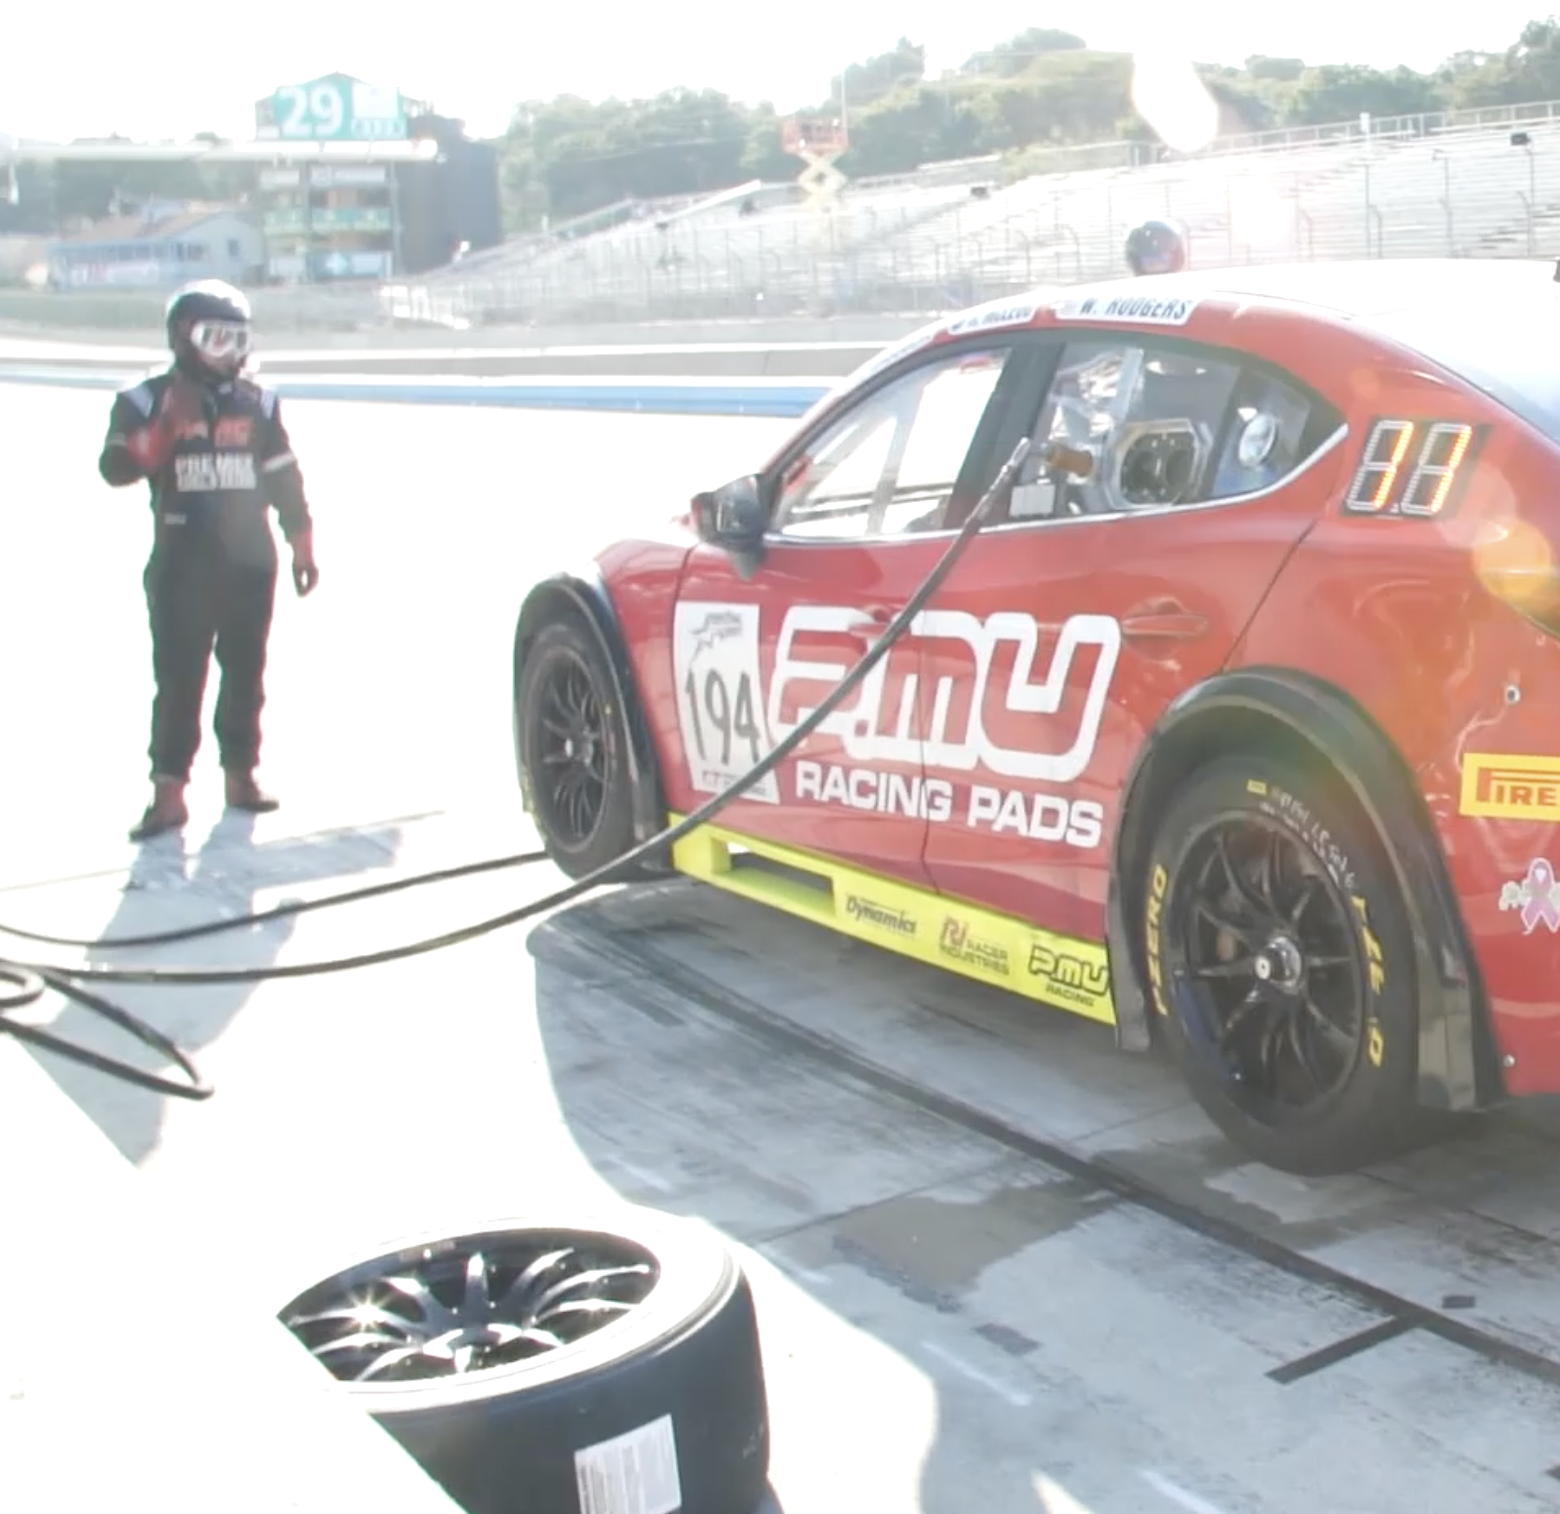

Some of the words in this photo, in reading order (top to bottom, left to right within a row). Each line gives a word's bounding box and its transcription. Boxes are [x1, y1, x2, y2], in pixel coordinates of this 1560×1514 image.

[272, 82, 343, 138] 29
[684, 668, 763, 766] 194
[796, 760, 953, 822] RACING
[967, 785, 1104, 849] PADS
